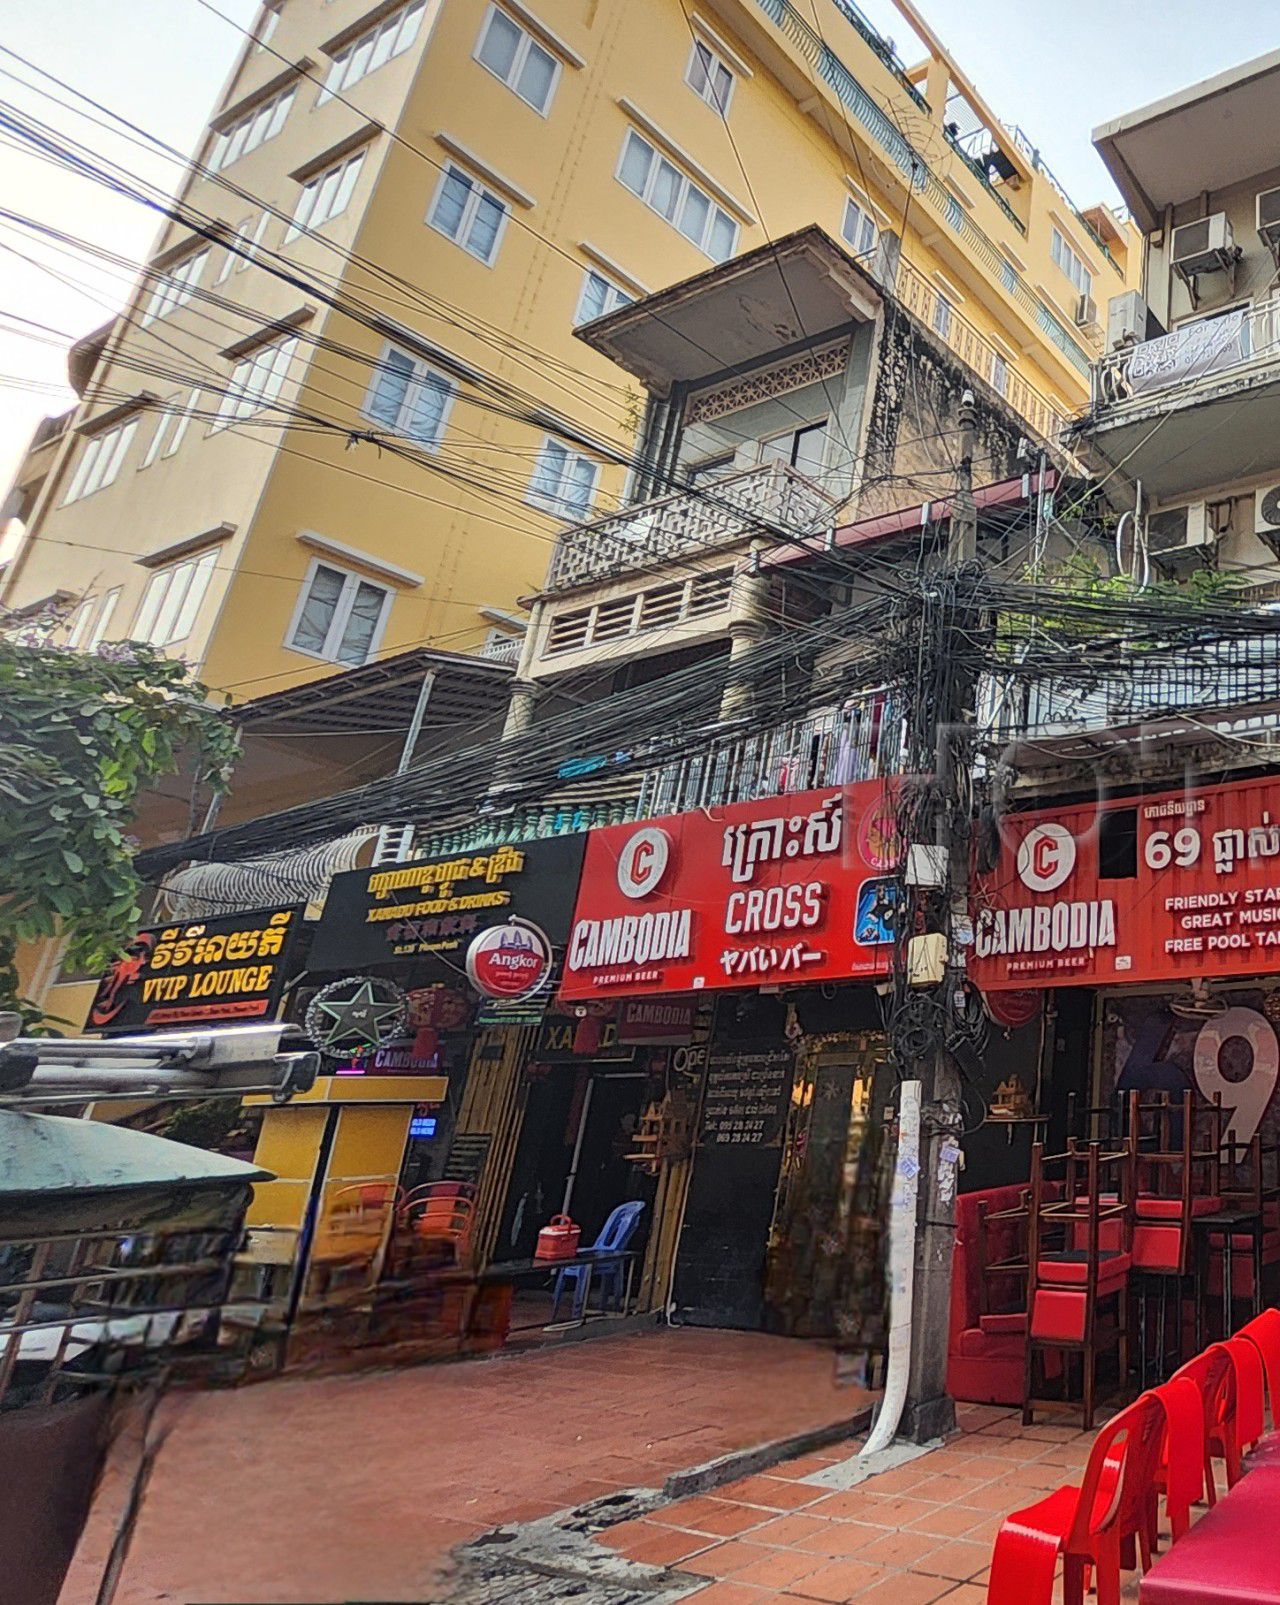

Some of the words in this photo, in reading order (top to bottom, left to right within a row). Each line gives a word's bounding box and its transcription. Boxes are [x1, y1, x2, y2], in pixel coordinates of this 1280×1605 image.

[1144, 827, 1201, 870] 69
[416, 898, 450, 917] FOOD
[460, 890, 512, 912] DRINKS
[724, 882, 823, 937] CROSS
[1164, 891, 1238, 912] FRIENDLY
[974, 899, 1116, 960] CAMBODIA
[1181, 911, 1234, 930] GREAT
[568, 908, 693, 973] CAMBODIA
[1164, 938, 1204, 954] FREE
[1208, 933, 1252, 950] POOL
[488, 952, 539, 971] Angkor
[1006, 958, 1054, 973] PREMIUM
[1057, 956, 1086, 969] BEER
[142, 974, 188, 1004] VVIP
[189, 964, 274, 999] LOUNGE
[593, 972, 633, 986] PREMIUM
[634, 970, 659, 983] BEER
[625, 1002, 692, 1026] CAMBODIA
